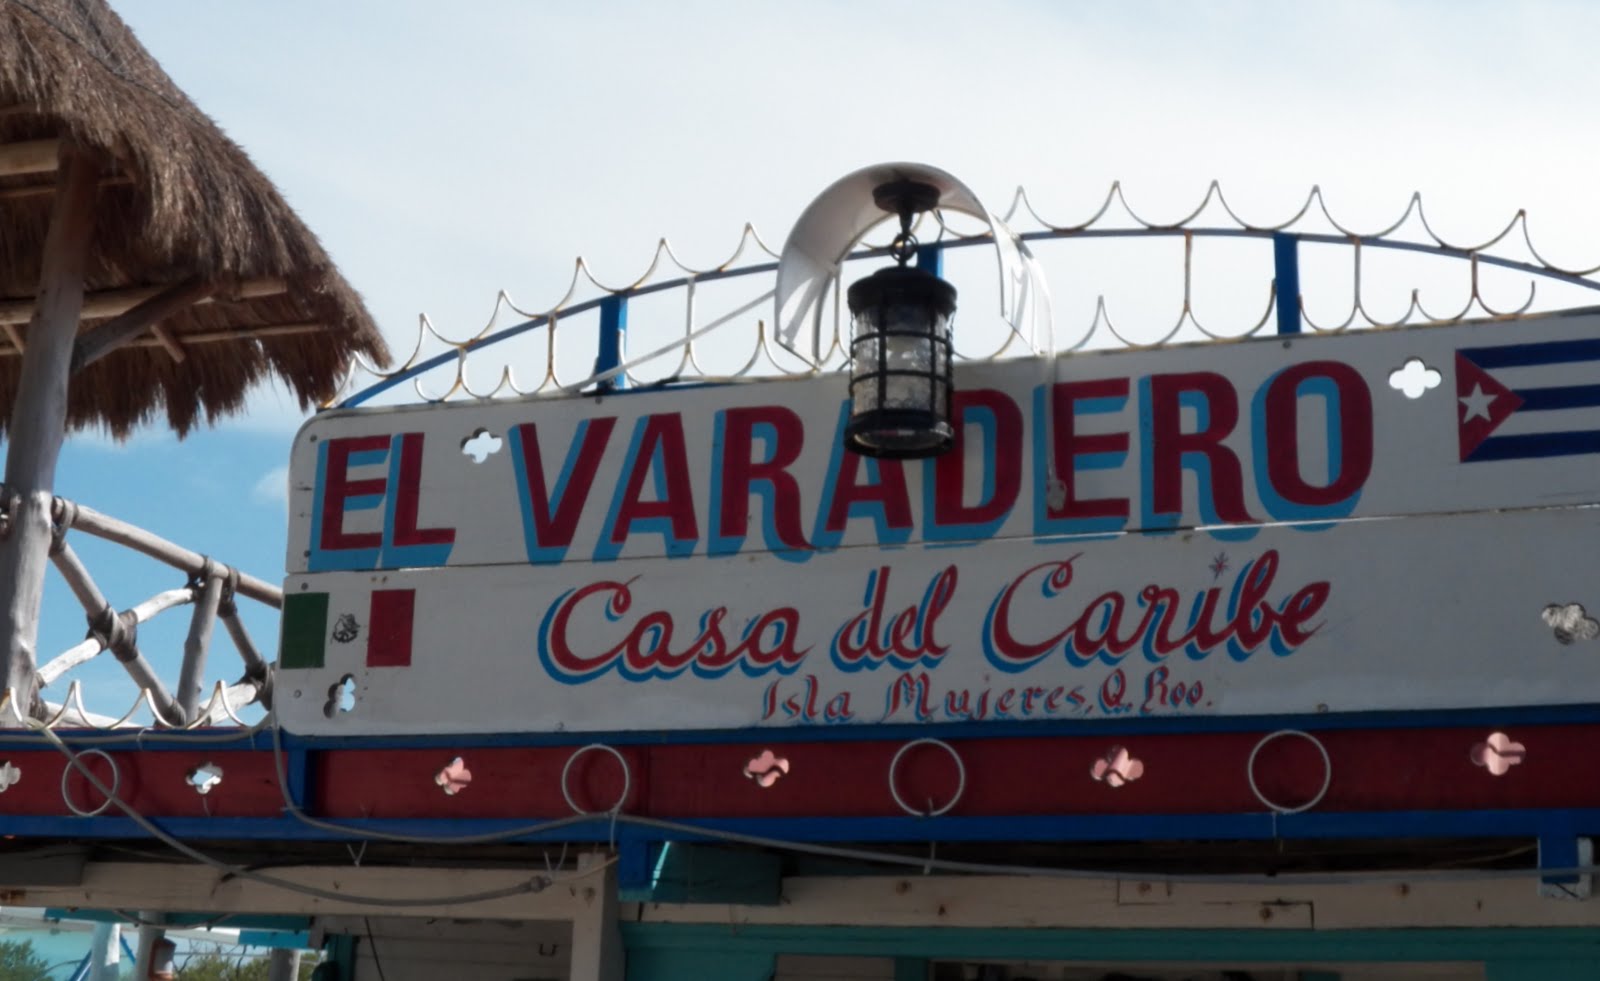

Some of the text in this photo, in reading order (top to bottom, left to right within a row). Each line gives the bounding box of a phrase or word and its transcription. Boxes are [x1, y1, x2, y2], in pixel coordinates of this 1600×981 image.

[308, 360, 1374, 570] EL VARADERO
[538, 549, 1332, 685] Casa del Caribe
[762, 674, 855, 724] Isla
[881, 671, 1094, 722] Mujeres,
[1140, 665, 1214, 716] Roo.
